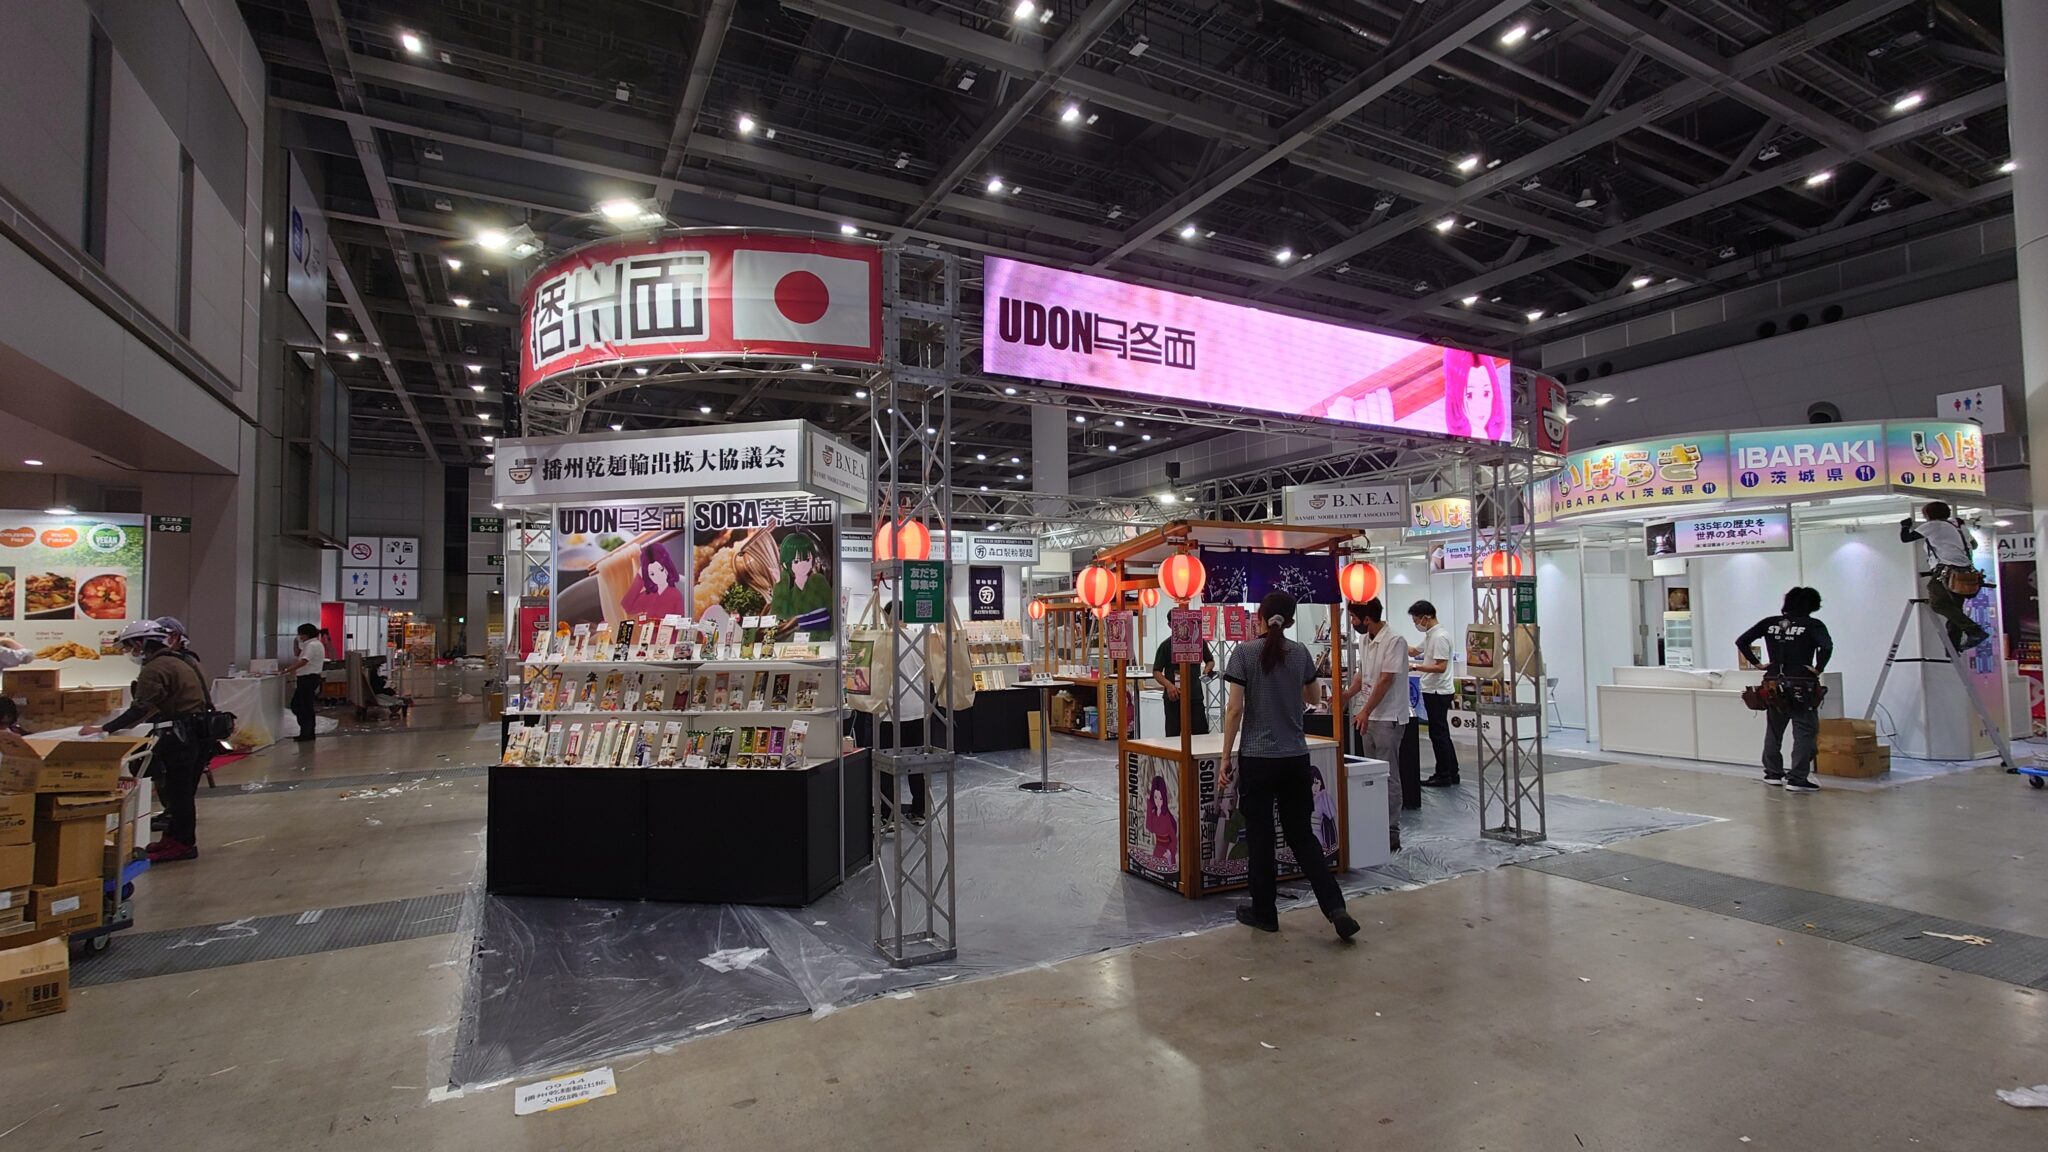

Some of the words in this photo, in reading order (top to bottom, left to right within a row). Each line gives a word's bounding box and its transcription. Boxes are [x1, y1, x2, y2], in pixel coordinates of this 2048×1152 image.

[1738, 440, 1876, 470] IBARAKI
[1771, 468, 1844, 484] 茨城県
[1922, 472, 1981, 485] IBARA
[1332, 491, 1399, 507] B.N.E.A.
[159, 524, 182, 532] 9-49
[1694, 518, 1766, 531] 335年の歴史を
[910, 567, 938, 578] 友だち
[910, 579, 938, 591] 募集中
